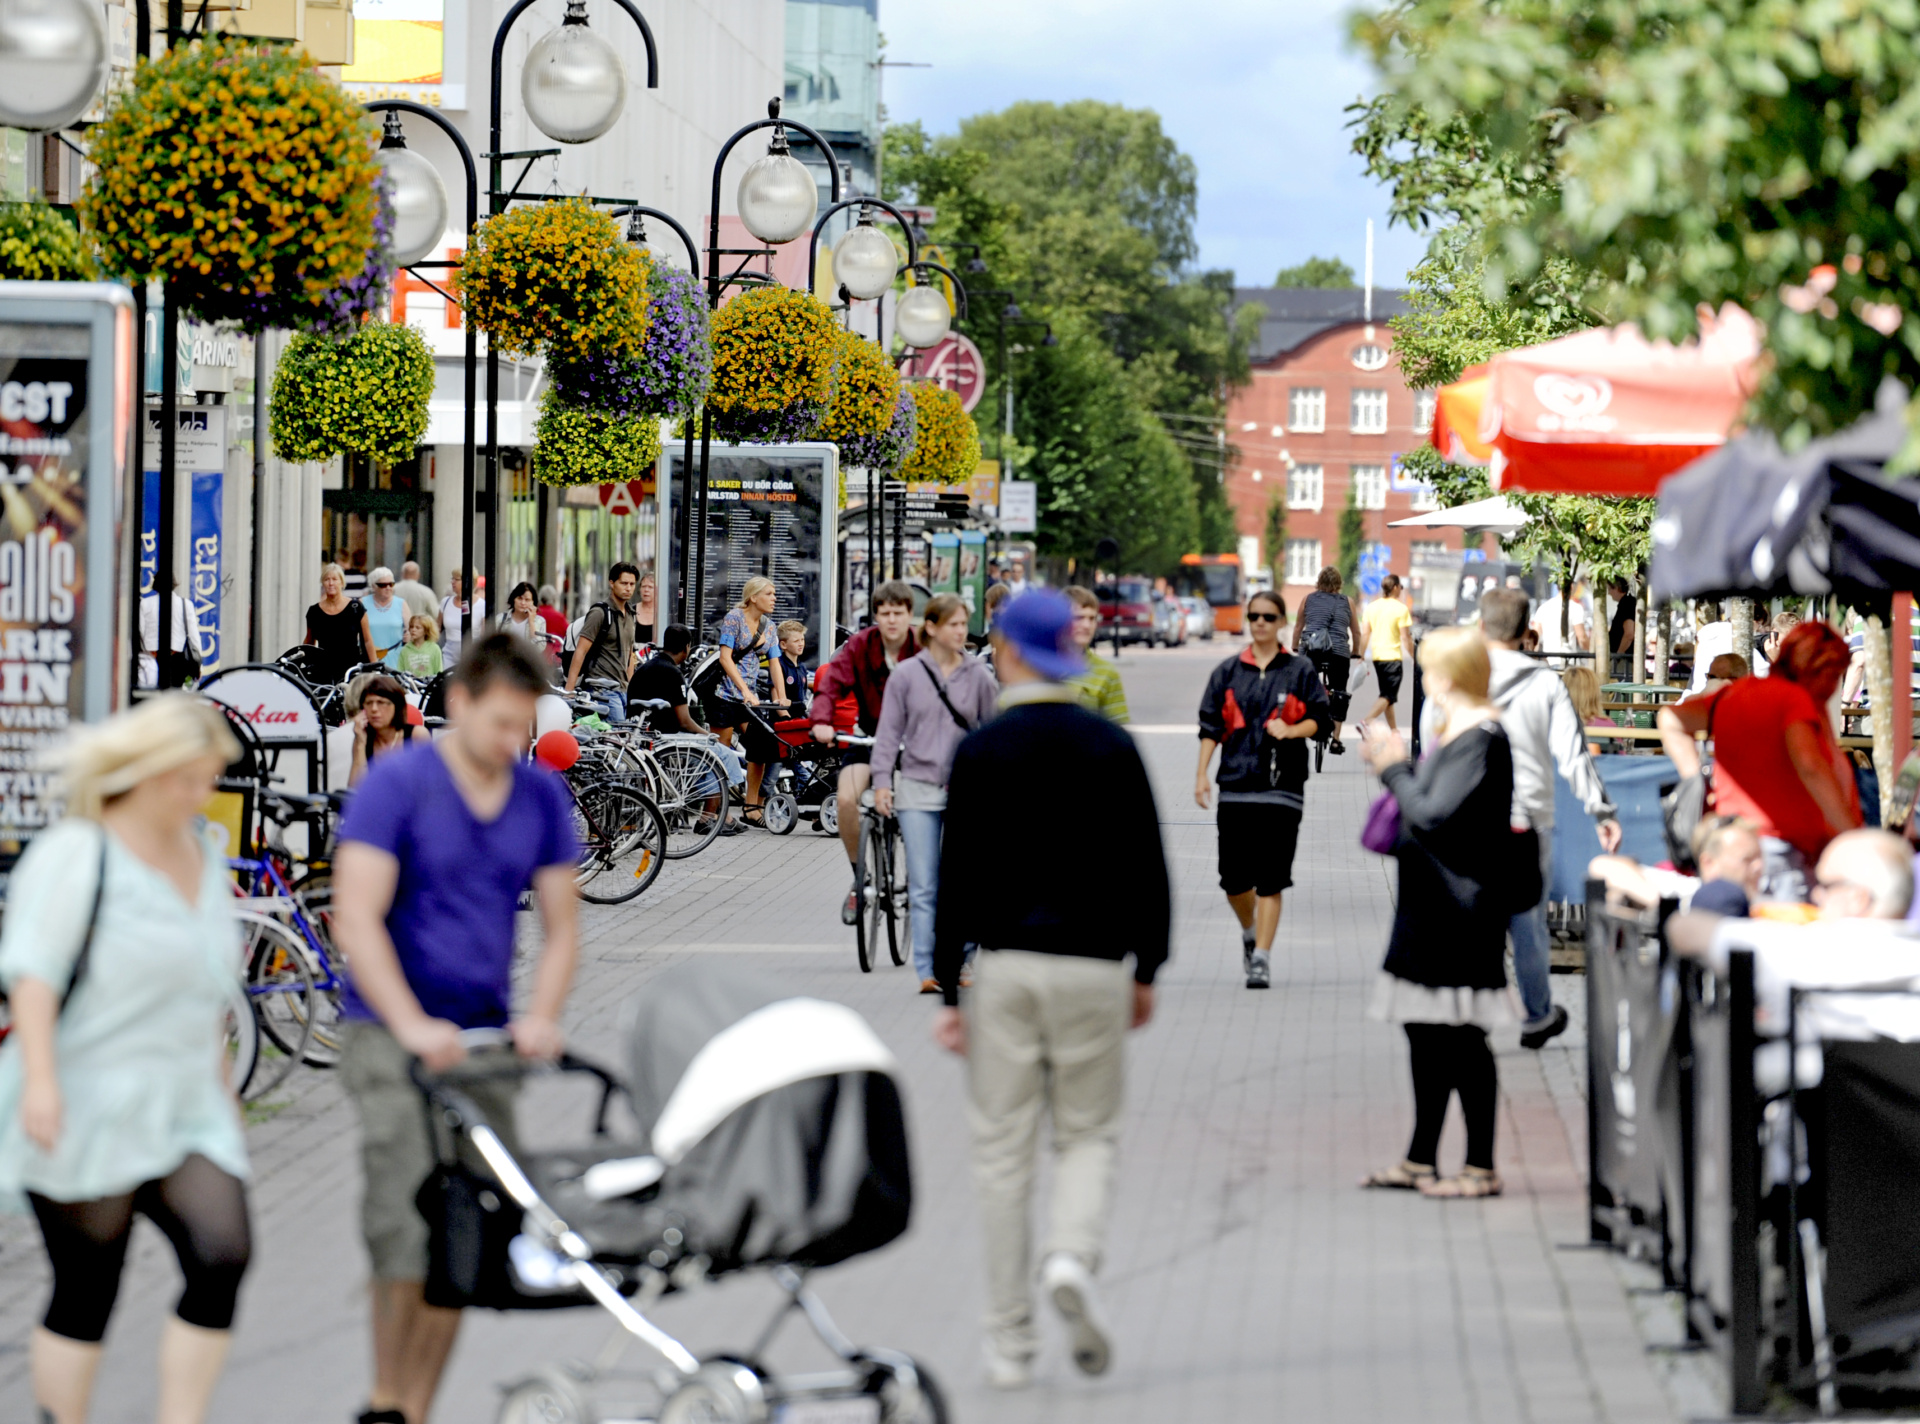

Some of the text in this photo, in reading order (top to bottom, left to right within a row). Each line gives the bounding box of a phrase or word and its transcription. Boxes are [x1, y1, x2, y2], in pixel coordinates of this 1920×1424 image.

[147, 420, 205, 434] KMG
[716, 480, 741, 489] SAKER
[741, 481, 754, 490] DU
[755, 479, 771, 490] BÖR
[772, 480, 794, 490] GÖRA
[707, 491, 740, 500] ARLSTAD
[741, 492, 765, 501] INNAN
[766, 492, 797, 502] HÖSTEN
